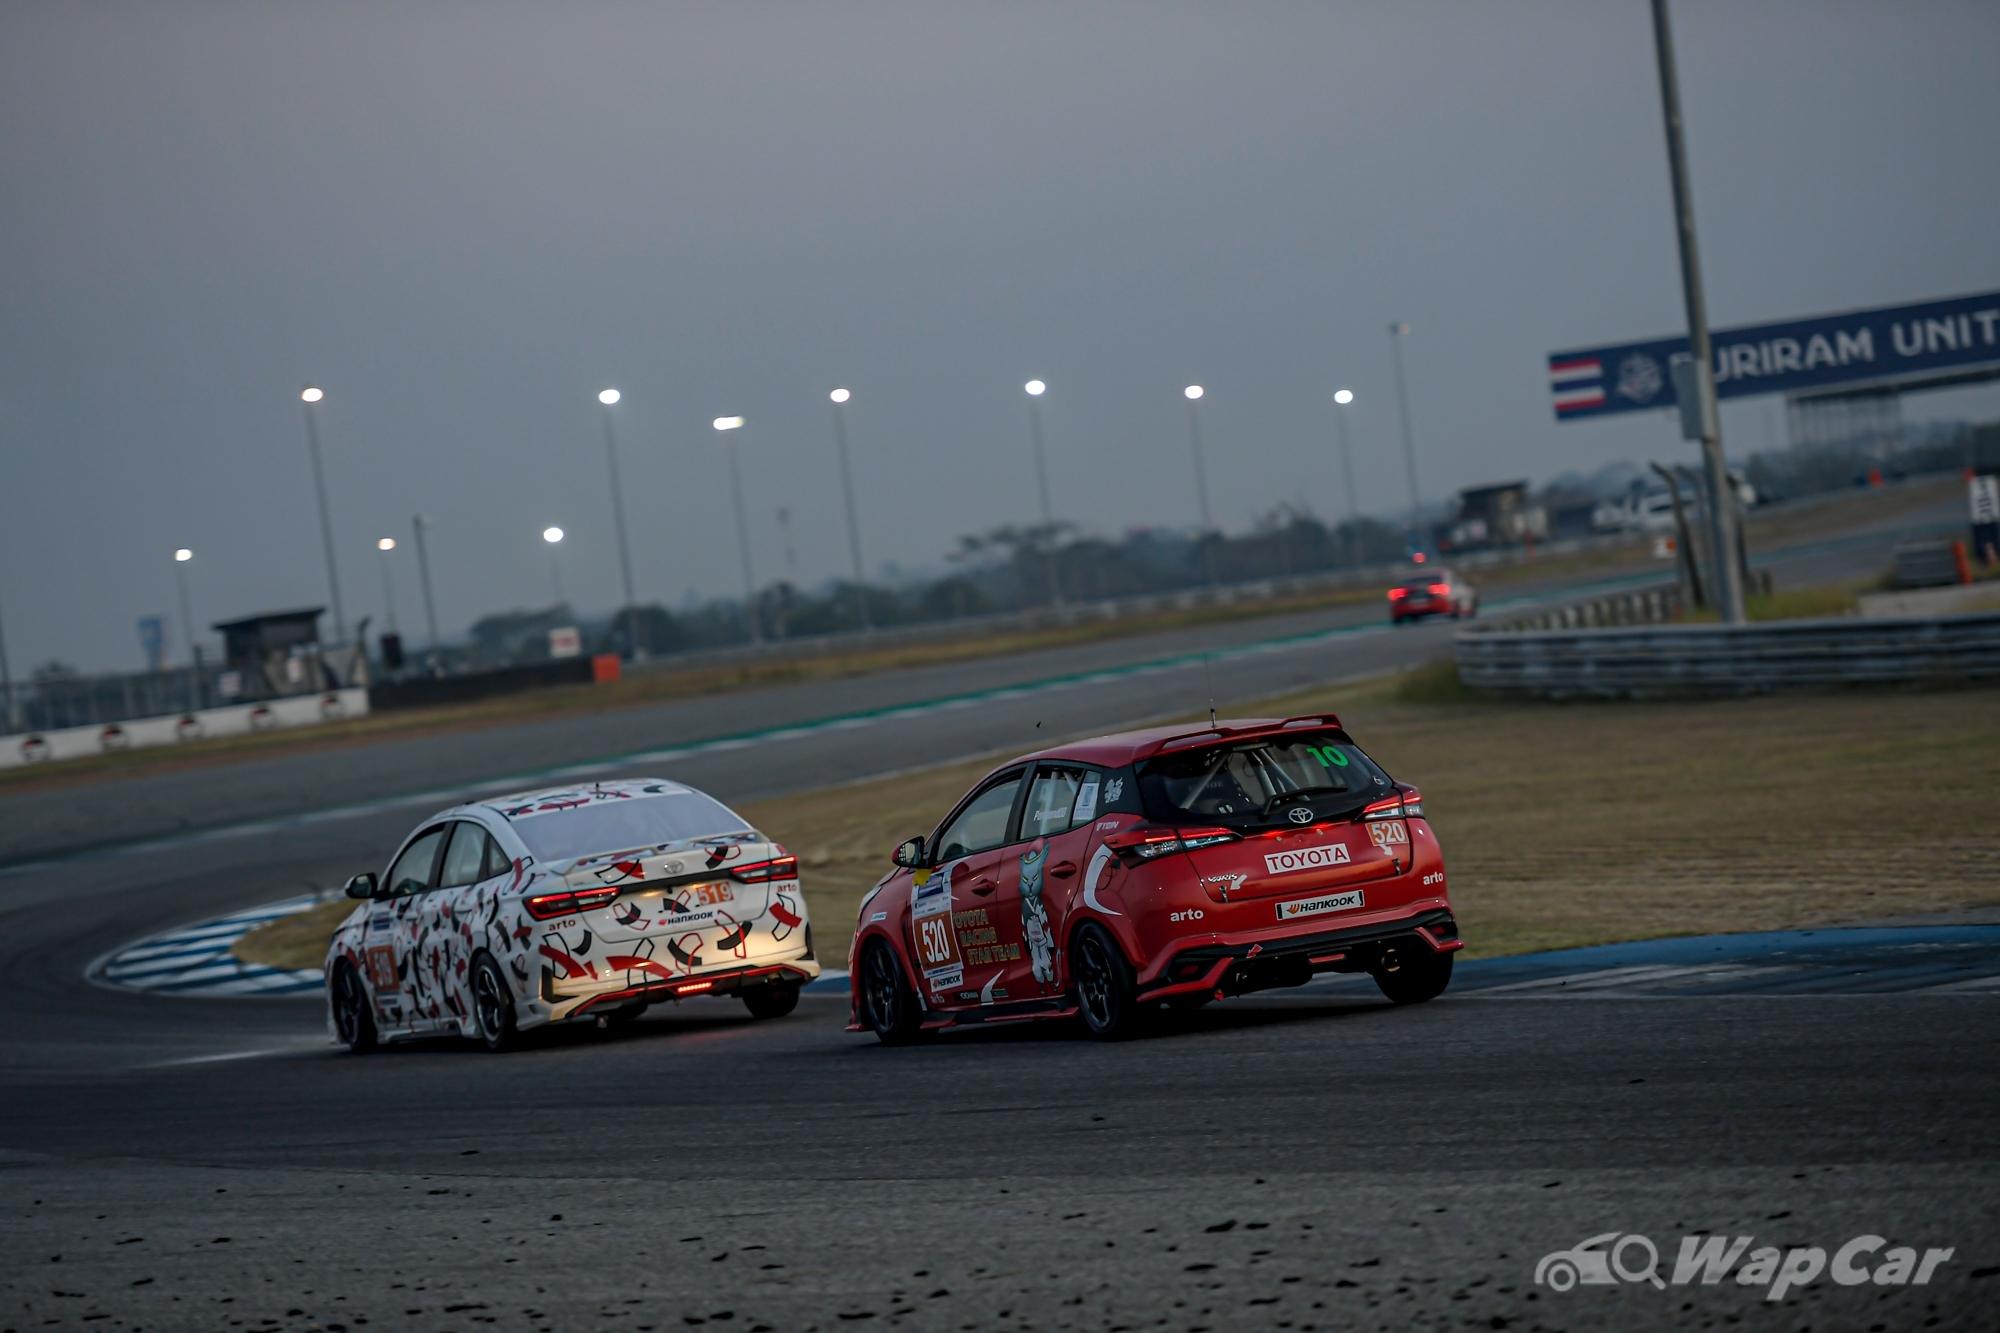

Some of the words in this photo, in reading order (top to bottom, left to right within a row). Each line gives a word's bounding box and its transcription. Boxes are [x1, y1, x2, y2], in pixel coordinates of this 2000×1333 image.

[1669, 327, 1874, 384] URIRAM
[1305, 744, 1350, 768] 10
[1371, 822, 1405, 844] 520
[1267, 847, 1347, 870] TOYOTA
[777, 883, 797, 893] arto
[1423, 872, 1444, 885] arto
[698, 882, 732, 905] 519
[548, 918, 576, 932] arto
[1170, 907, 1204, 922] arto
[921, 919, 950, 963] 520
